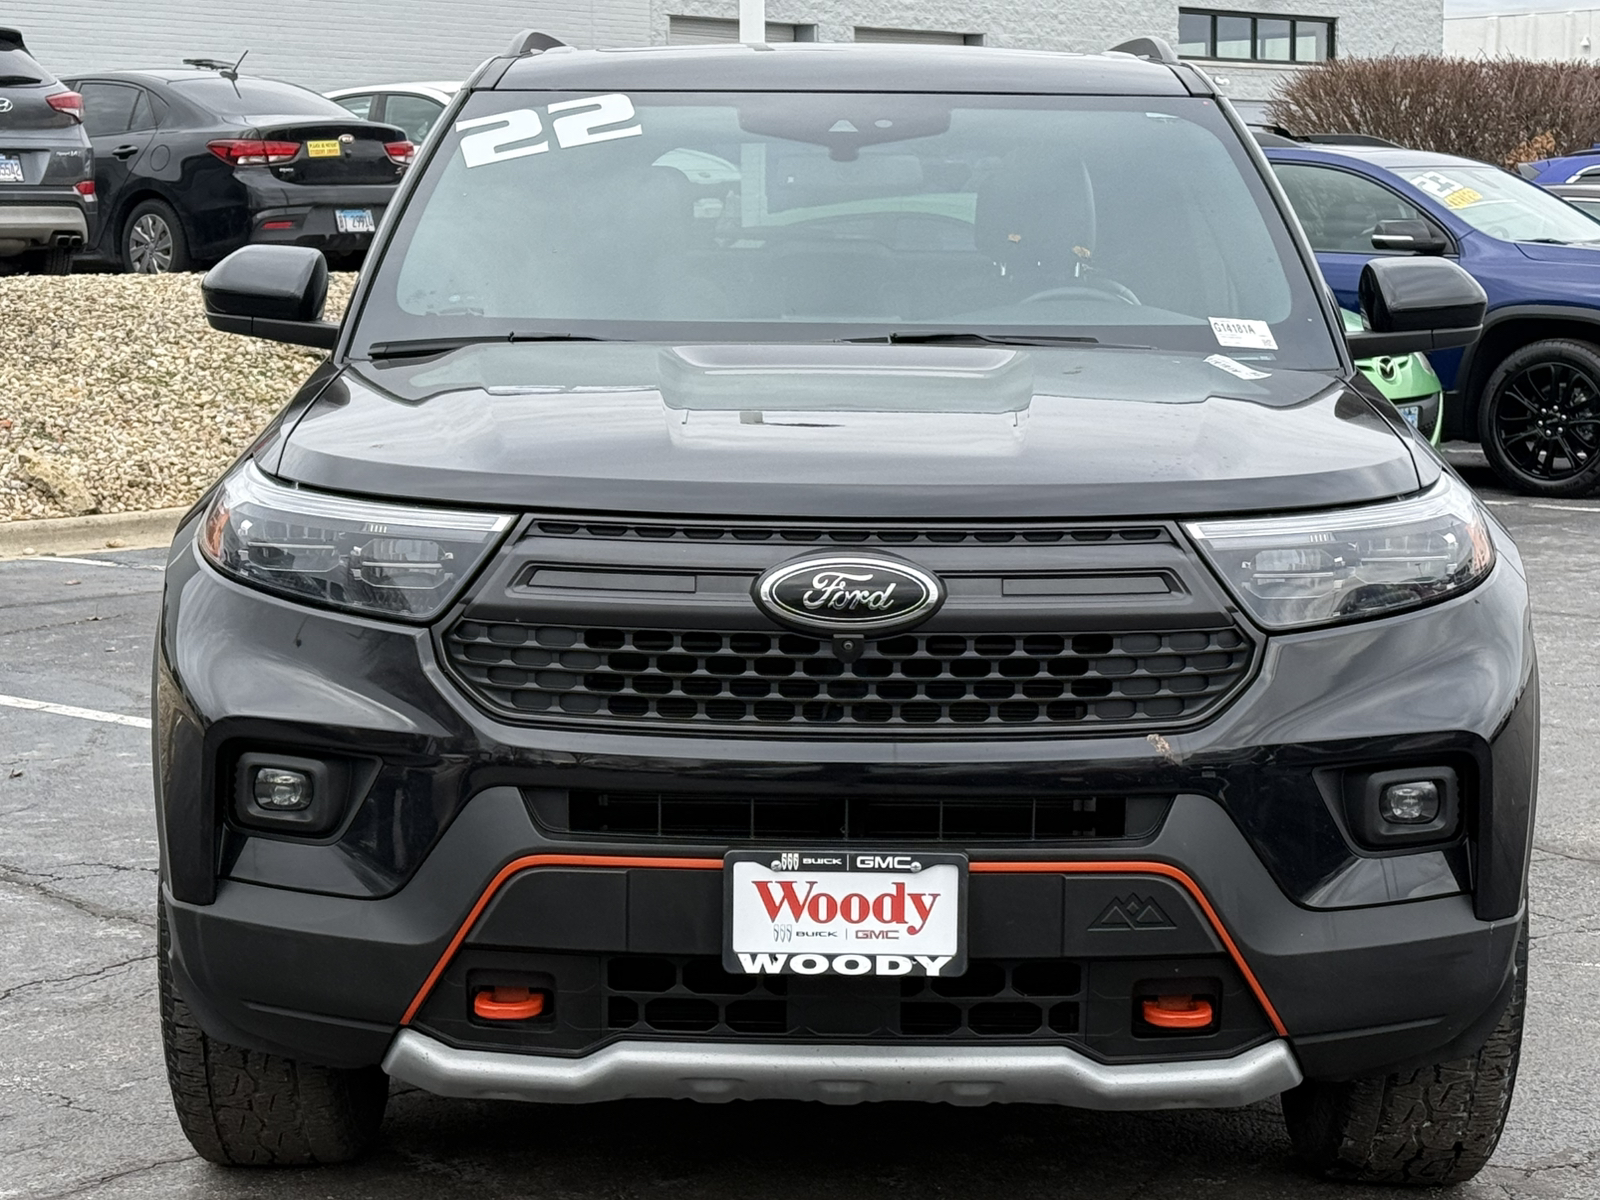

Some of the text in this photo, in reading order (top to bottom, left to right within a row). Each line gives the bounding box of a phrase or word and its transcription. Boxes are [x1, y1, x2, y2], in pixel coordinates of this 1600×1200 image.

[455, 93, 643, 169] 22
[0, 162, 21, 176] 5542
[1409, 170, 1464, 198] 23
[1213, 322, 1257, 335] G14181A
[802, 571, 897, 611] Ford
[802, 855, 912, 869] BUICK GMC
[751, 880, 941, 936] Woody
[796, 929, 900, 940] BUICK GMC
[737, 953, 953, 977] WOODY
